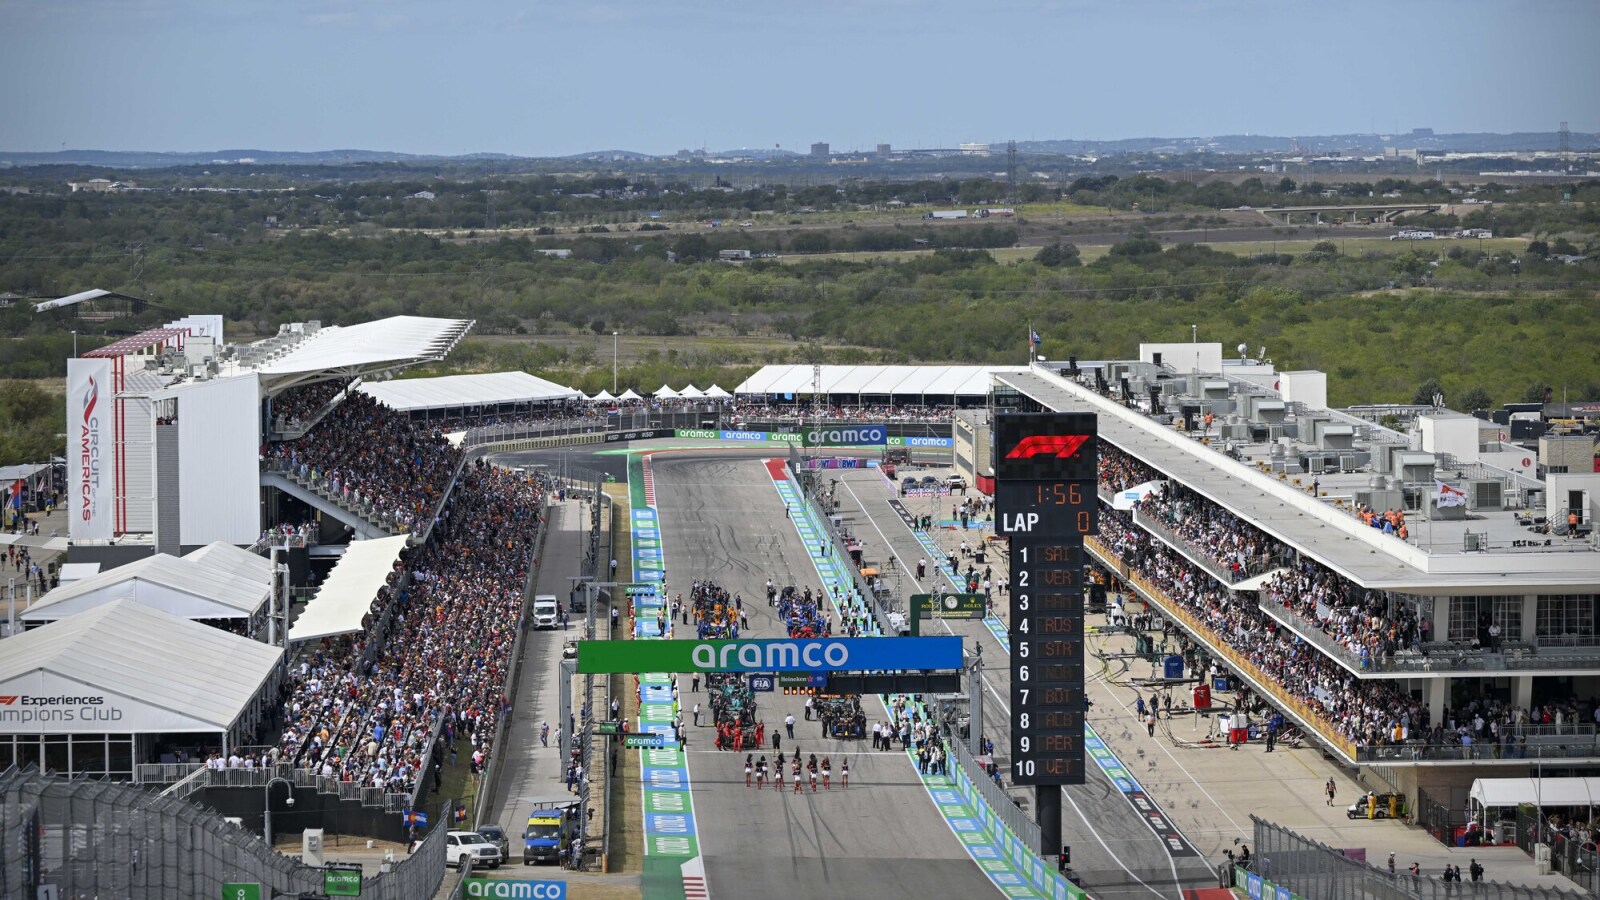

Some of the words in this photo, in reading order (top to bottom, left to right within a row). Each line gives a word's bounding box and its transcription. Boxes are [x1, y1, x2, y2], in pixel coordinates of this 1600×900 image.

[680, 430, 715, 439] aramco
[726, 431, 761, 440] aramco
[808, 429, 882, 443] aramco
[911, 437, 947, 446] aramco
[90, 417, 99, 488] CIRCUIT
[81, 425, 91, 521] AMERICAS
[1037, 484, 1081, 504] 1:56
[1003, 513, 1039, 532] LAP
[1020, 547, 1027, 563] 1
[1019, 571, 1029, 586] 2
[1046, 571, 1072, 584] VER
[1019, 594, 1029, 610] 3
[1019, 618, 1029, 634] 4
[692, 643, 848, 668] aramco
[1020, 642, 1029, 657] 5
[1046, 643, 1072, 656] STR
[1020, 666, 1029, 681] 6
[21, 695, 104, 706] Experiences
[1020, 689, 1029, 705] 7
[1046, 690, 1071, 703] BOT
[0, 708, 74, 723] mpions
[80, 707, 122, 720] Club
[1020, 713, 1029, 729] 8
[627, 737, 662, 745] aramco
[1021, 737, 1030, 752] 9
[1046, 737, 1072, 750] PER
[1016, 760, 1035, 776] 10
[1046, 761, 1071, 774] VET
[468, 881, 561, 899] aramco
